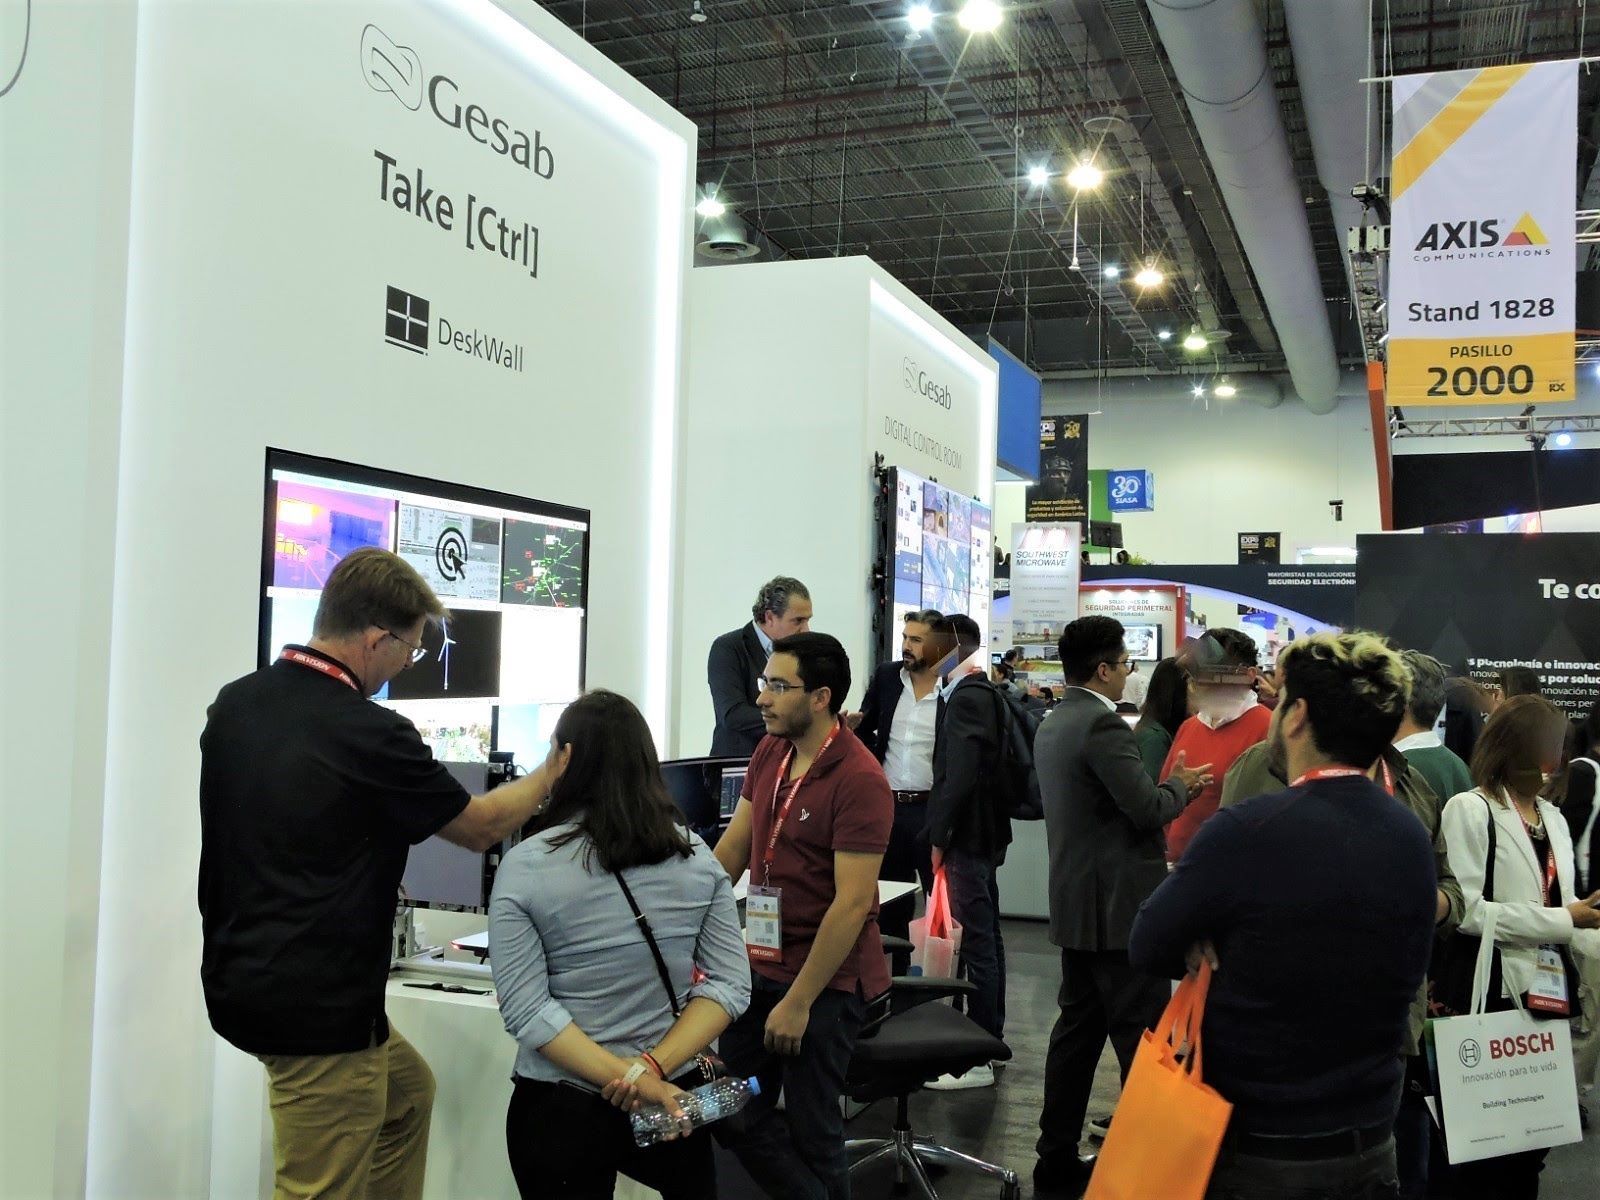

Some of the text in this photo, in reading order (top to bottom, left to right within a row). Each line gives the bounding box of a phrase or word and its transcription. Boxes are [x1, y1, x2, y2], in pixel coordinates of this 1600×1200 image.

[428, 75, 555, 181] Gesab
[374, 149, 539, 279] Take [Ctrl]
[1414, 219, 1500, 251] AXIS
[1413, 249, 1551, 262] COMMUNICATIONS
[1408, 298, 1555, 323] Stand 1828
[438, 317, 524, 373] DeskWall
[1450, 344, 1513, 358] PASILLO
[918, 371, 952, 410] Gesab
[1427, 364, 1534, 397] 2000
[884, 415, 962, 469] DIGITAL CONTROL ROOM
[1016, 550, 1069, 558] SOUTHWEST
[1538, 578, 1600, 600] Te co
[1127, 604, 1174, 612] PERIMETRAL
[1547, 675, 1569, 685] por
[1489, 1032, 1555, 1060] BOSCH
[1462, 1060, 1558, 1084] Innovación para tu vida
[1482, 1093, 1545, 1109] Building Technologies
